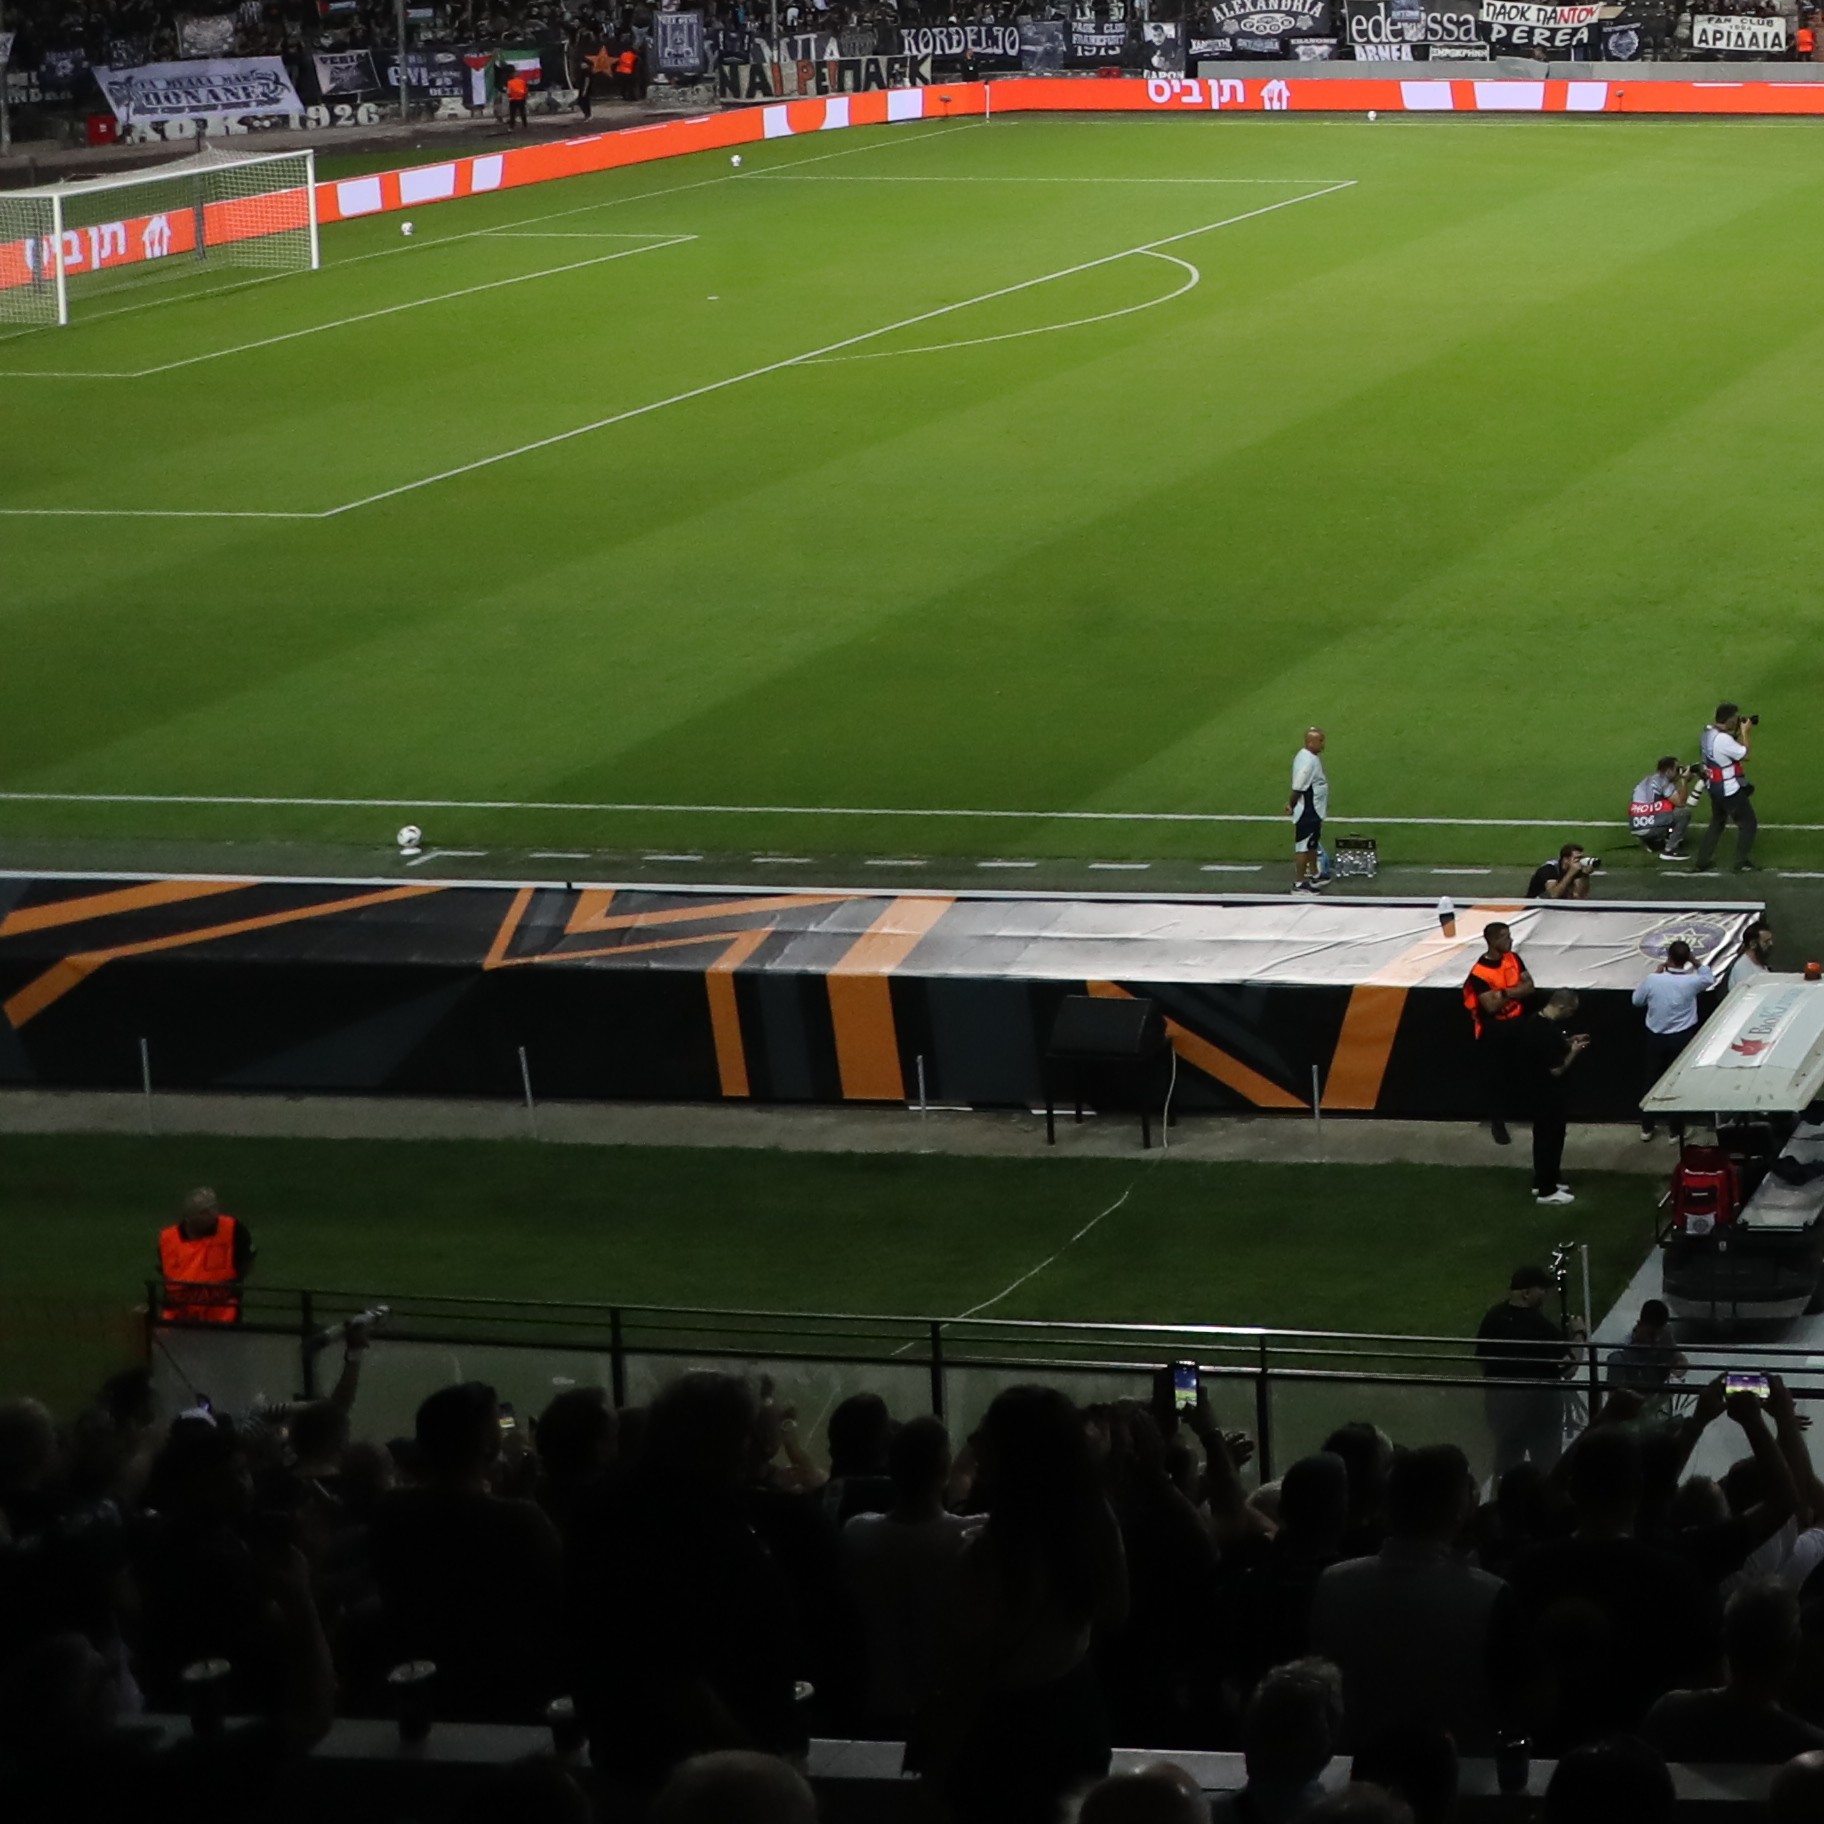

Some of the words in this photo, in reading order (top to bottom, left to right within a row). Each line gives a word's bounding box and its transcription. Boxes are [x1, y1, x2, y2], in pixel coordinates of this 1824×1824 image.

[1740, 18, 1774, 27] CLUB
[1490, 23, 1589, 47] PEREA
[1697, 28, 1783, 49] ΑΡΙΔΑΙΑ
[1147, 79, 1204, 103] ביס
[1208, 79, 1245, 110] תן
[1632, 814, 1655, 828] 006
